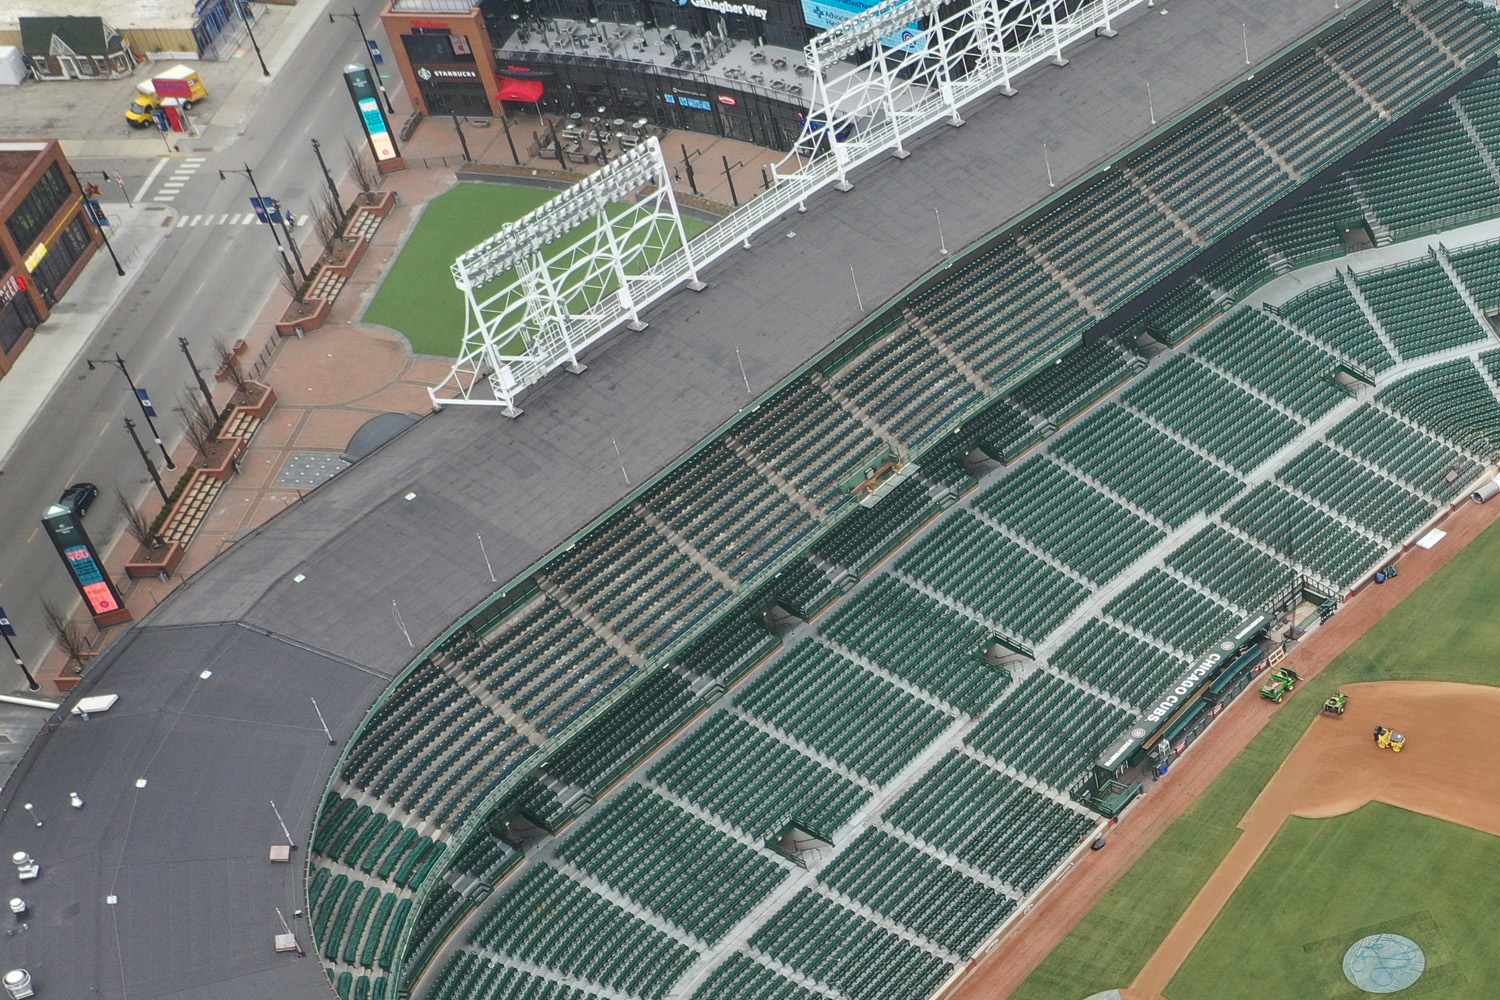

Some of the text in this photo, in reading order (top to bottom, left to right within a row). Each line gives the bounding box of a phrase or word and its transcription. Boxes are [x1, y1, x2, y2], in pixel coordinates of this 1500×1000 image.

[743, 4, 768, 20] Way
[433, 70, 477, 78] STARBUCKS
[1147, 653, 1221, 723] CHICAGO CUBS
